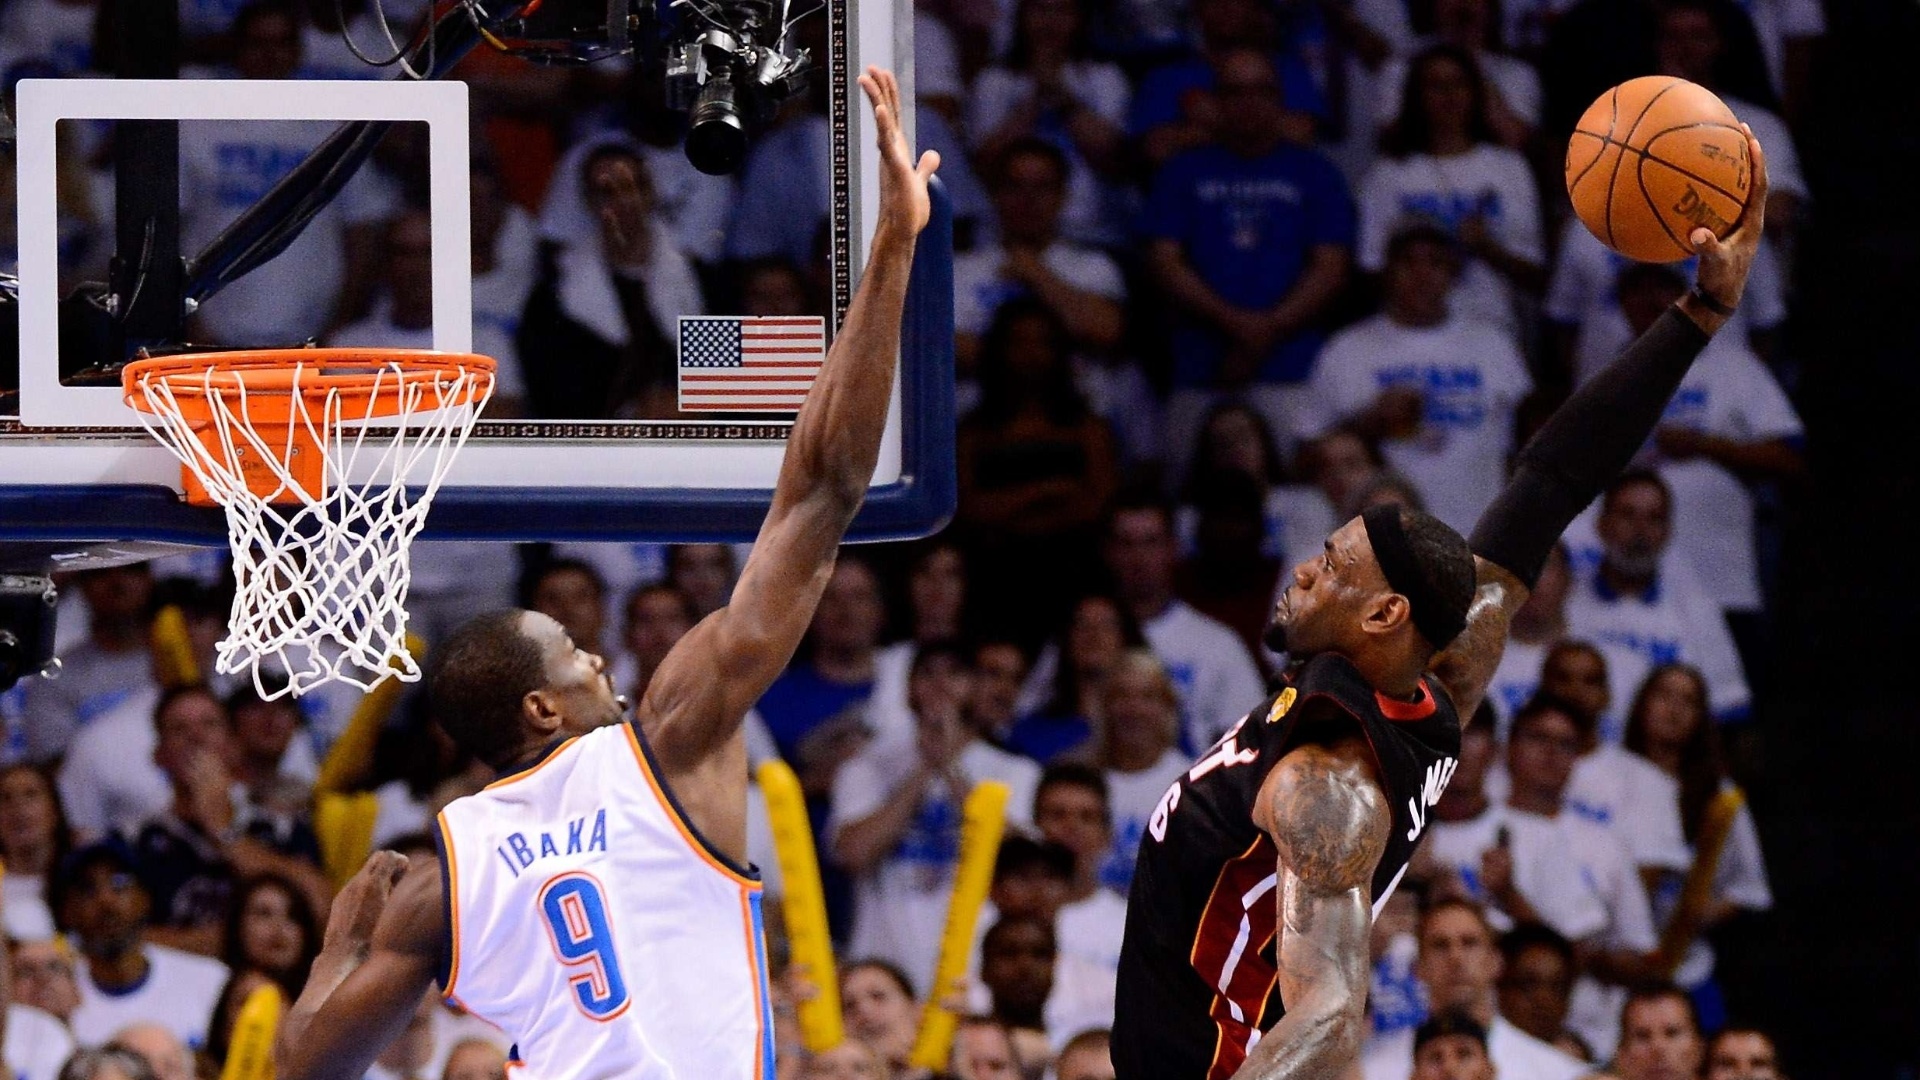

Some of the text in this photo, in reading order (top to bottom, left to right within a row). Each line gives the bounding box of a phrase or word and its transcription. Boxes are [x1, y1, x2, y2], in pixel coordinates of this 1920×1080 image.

[498, 808, 607, 878] IBAKA
[1149, 782, 1181, 842] 6
[537, 871, 631, 1022] 9
